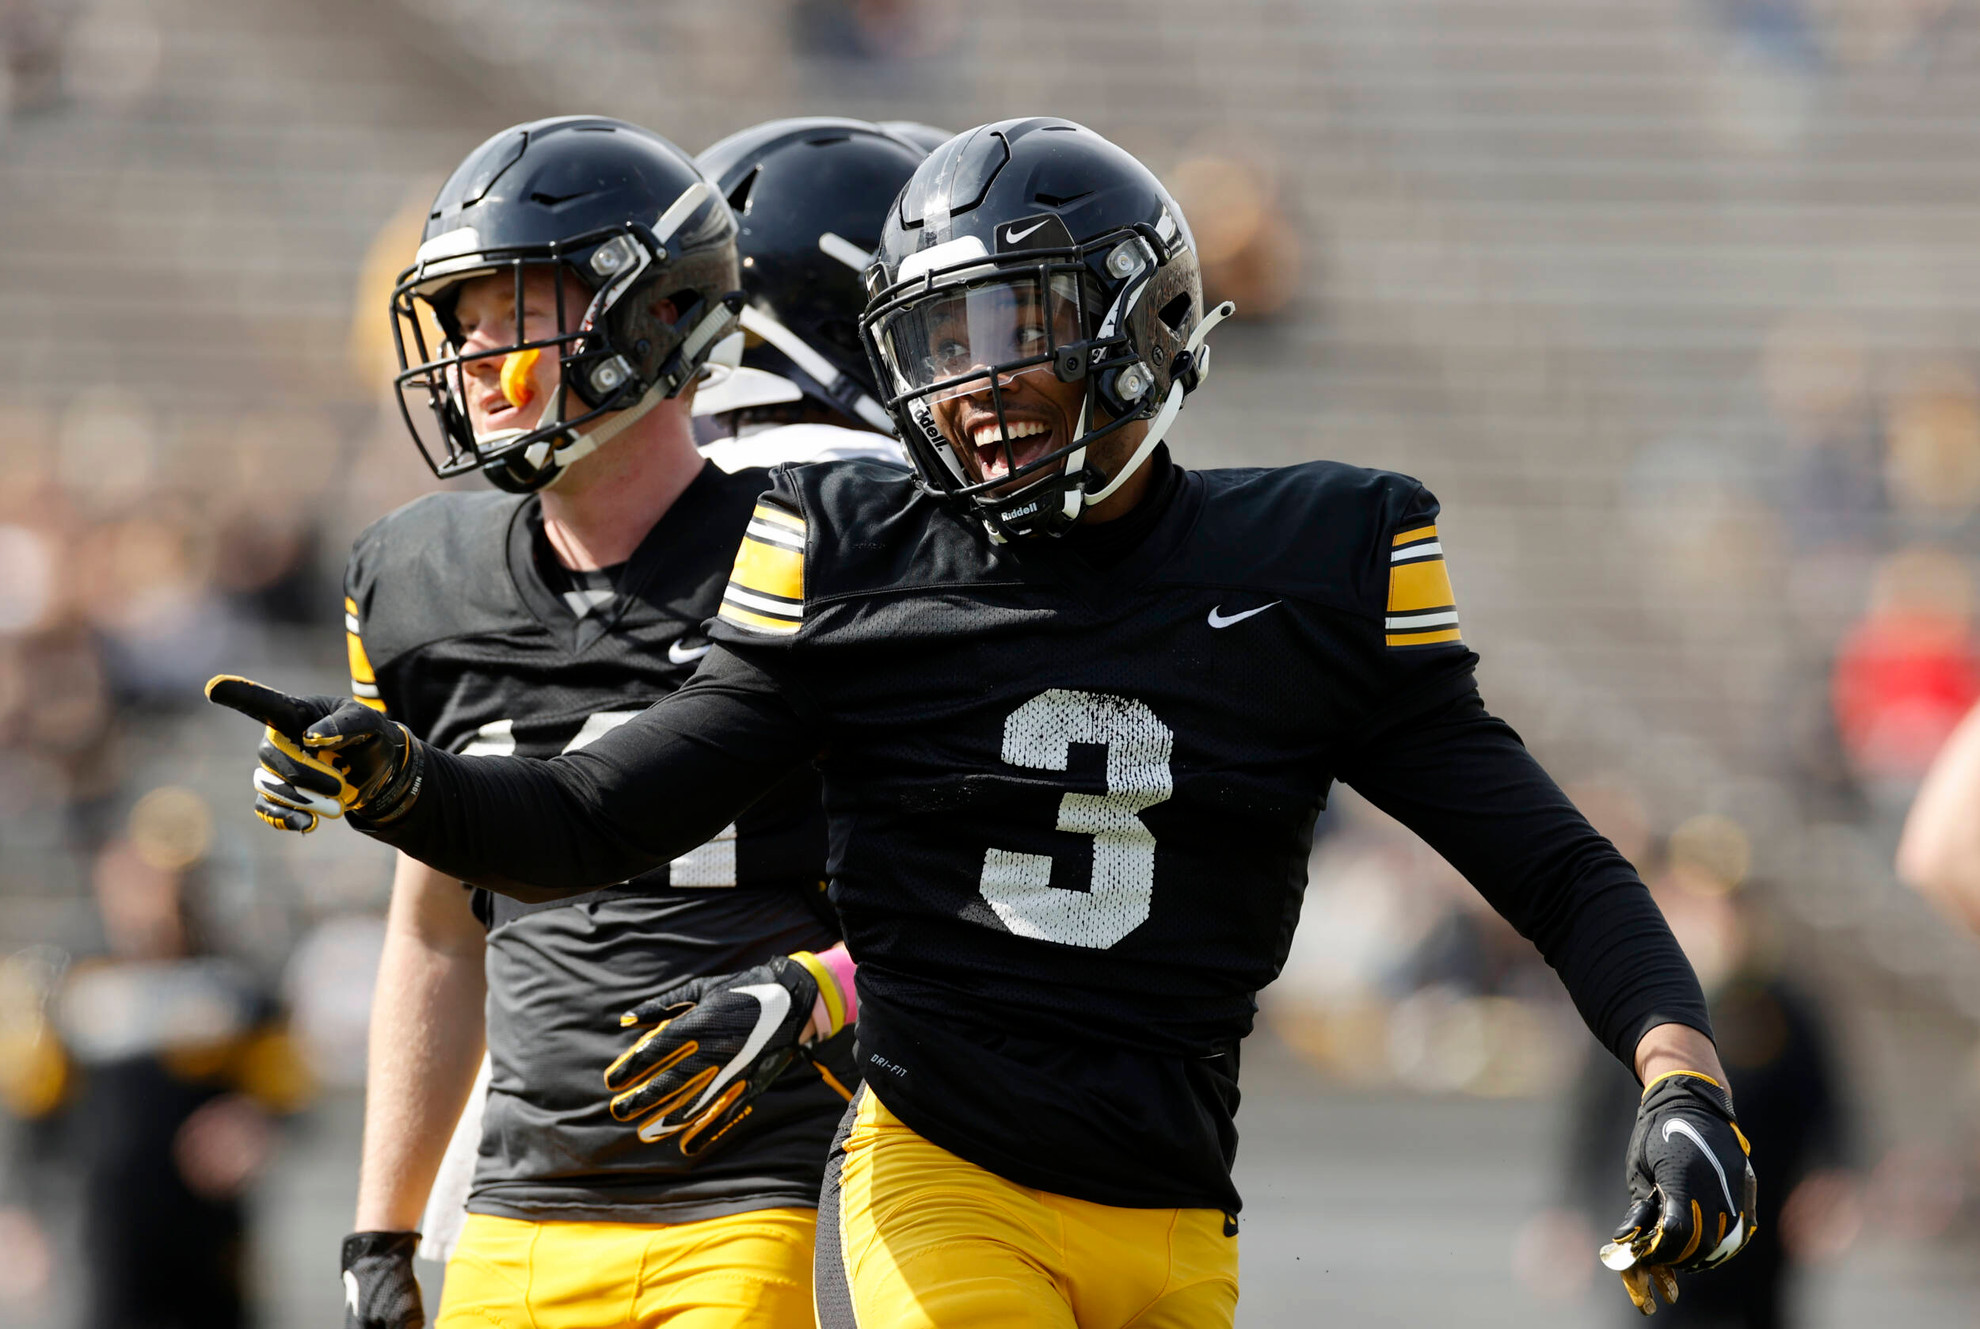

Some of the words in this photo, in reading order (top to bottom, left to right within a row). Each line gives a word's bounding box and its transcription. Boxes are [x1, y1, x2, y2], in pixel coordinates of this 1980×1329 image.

[1001, 502, 1038, 522] Riddell
[979, 688, 1174, 950] 3
[870, 1054, 907, 1077] DRI-FIT
